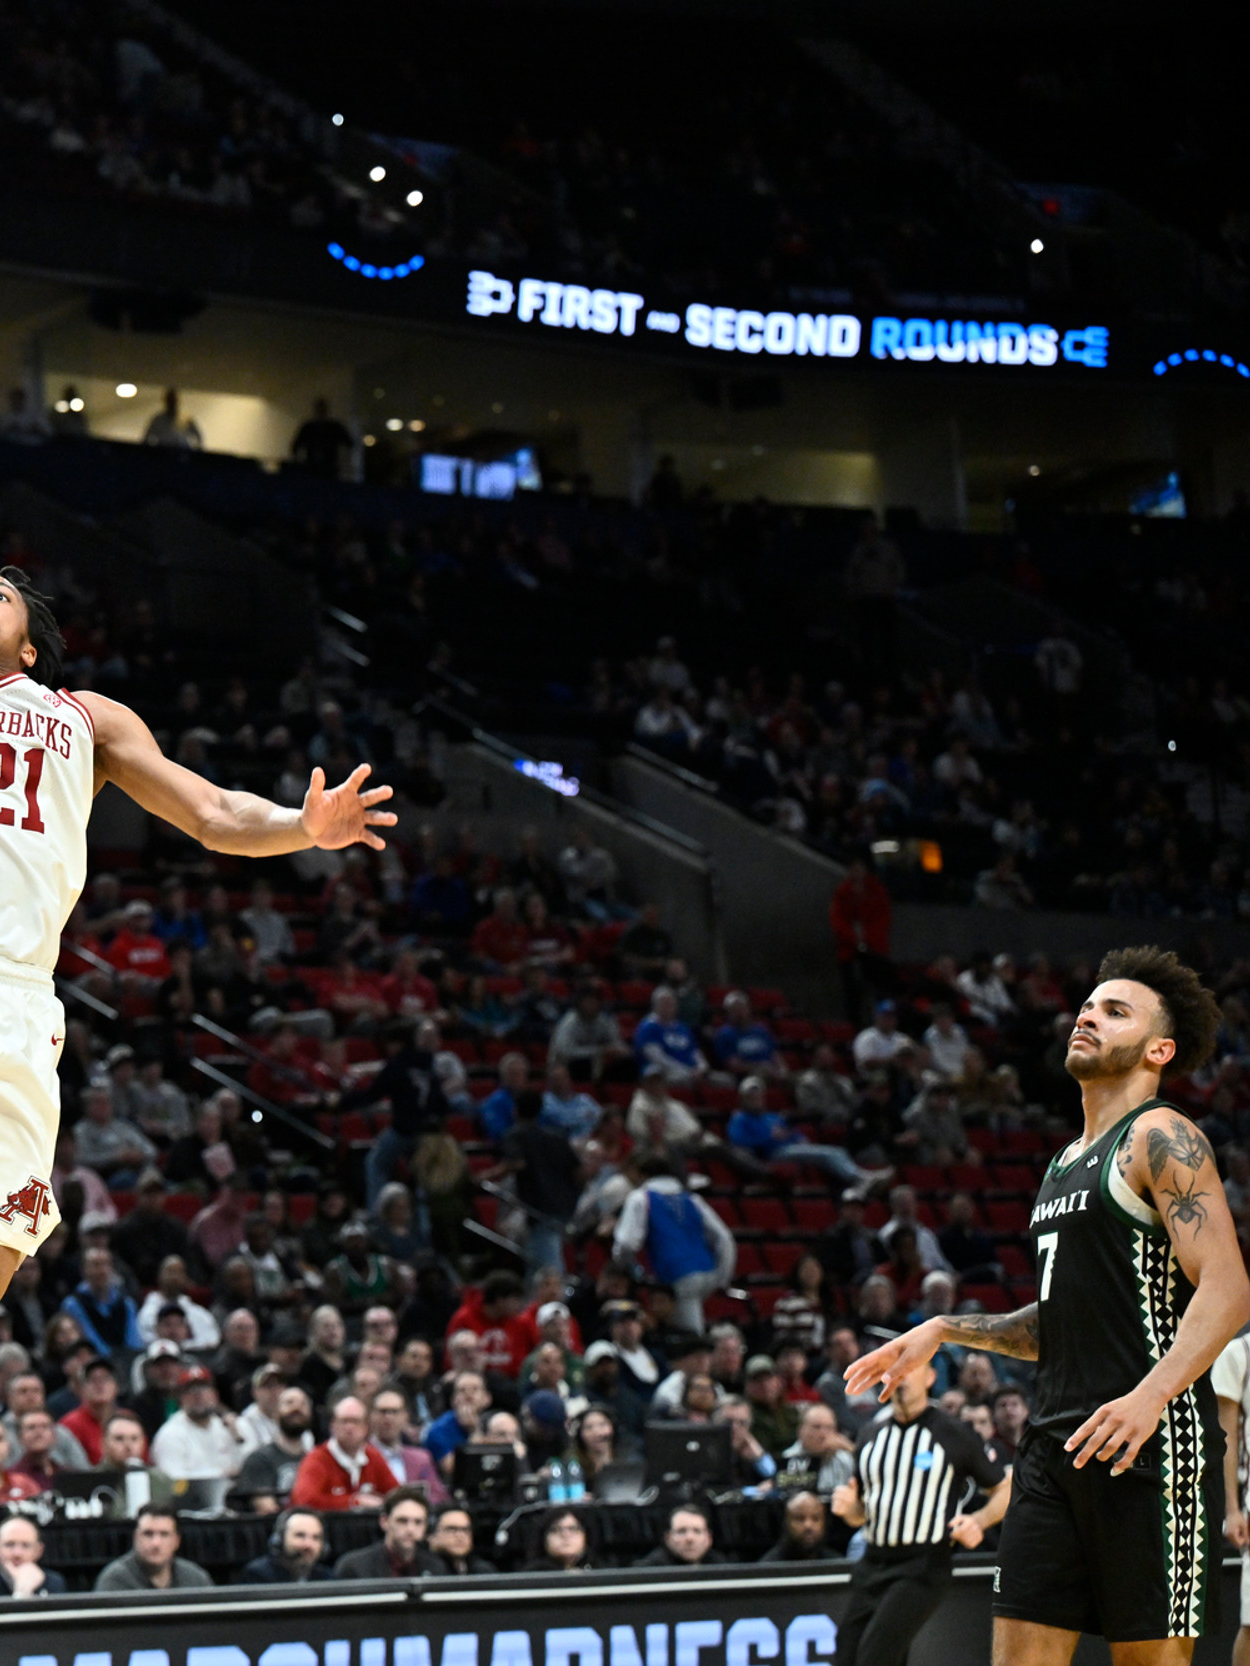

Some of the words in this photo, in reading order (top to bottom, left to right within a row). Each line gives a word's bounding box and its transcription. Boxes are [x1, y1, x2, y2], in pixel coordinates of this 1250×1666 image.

[517, 278, 645, 337] FIRST
[684, 303, 862, 358] SECOND
[870, 316, 1059, 366] ROUNDS
[1029, 1189, 1090, 1229] AWAI'I
[1037, 1231, 1059, 1302] 7
